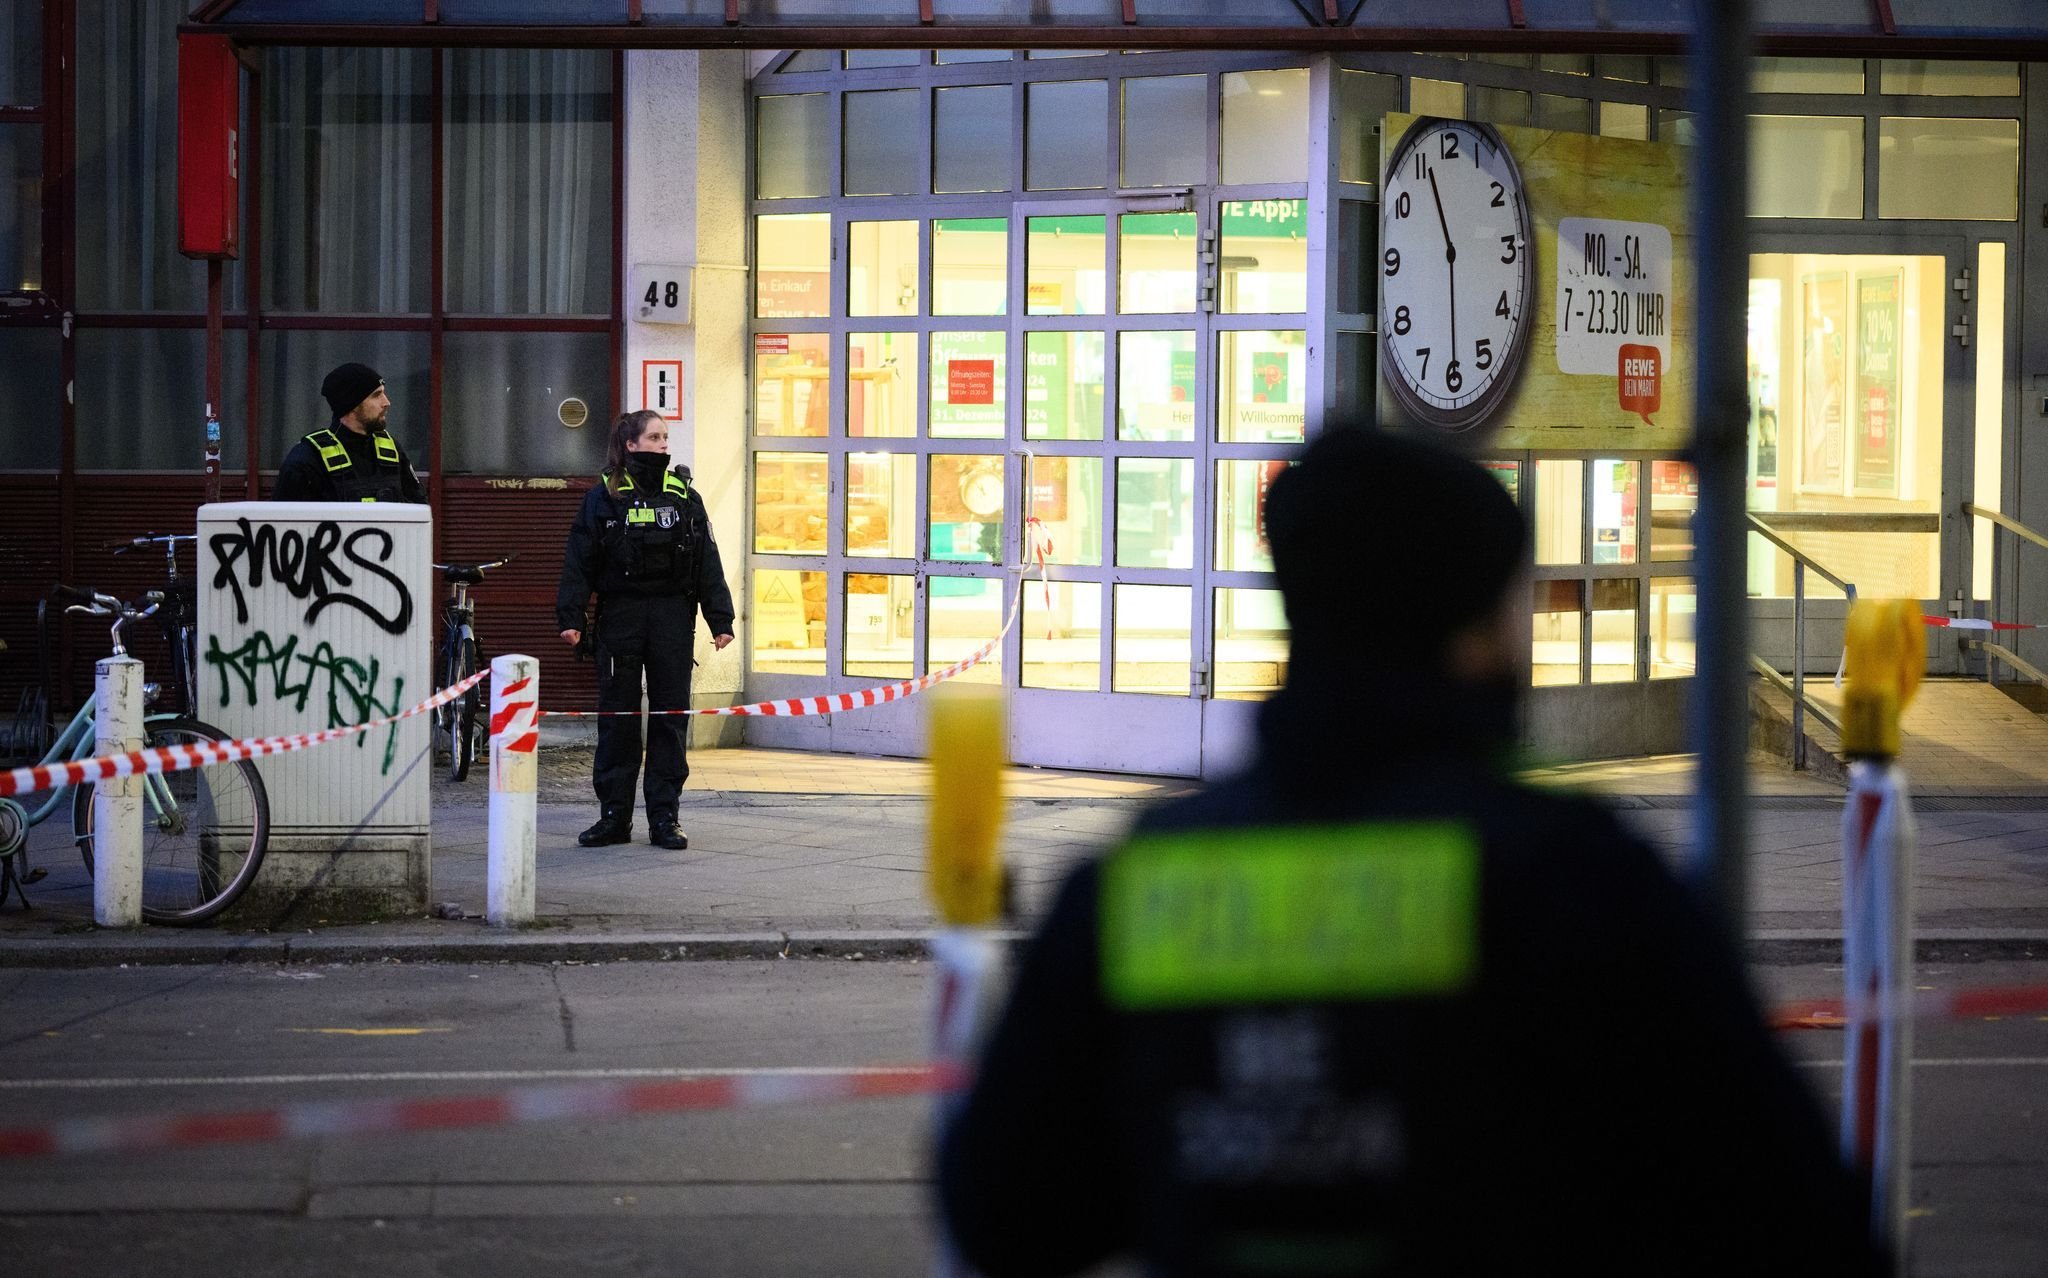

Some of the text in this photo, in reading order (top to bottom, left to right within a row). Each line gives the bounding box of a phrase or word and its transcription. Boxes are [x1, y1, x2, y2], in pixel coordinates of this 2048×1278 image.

[1440, 133, 1459, 160] 12
[1416, 153, 1427, 180] 11
[1395, 192, 1411, 219] 10
[1490, 181, 1505, 208] 2
[1385, 248, 1400, 276] 9
[1500, 235, 1516, 265] 3
[644, 281, 679, 309] 48
[771, 279, 812, 293] Einkauf
[1495, 290, 1511, 320] 4
[1636, 292, 1665, 336] UHR
[1394, 306, 1412, 335] 8
[1416, 348, 1431, 380] 7
[1475, 339, 1492, 370] 5
[1624, 359, 1655, 377] REWE
[1446, 361, 1463, 393] 6
[1624, 379, 1655, 397] DEIN MARKT
